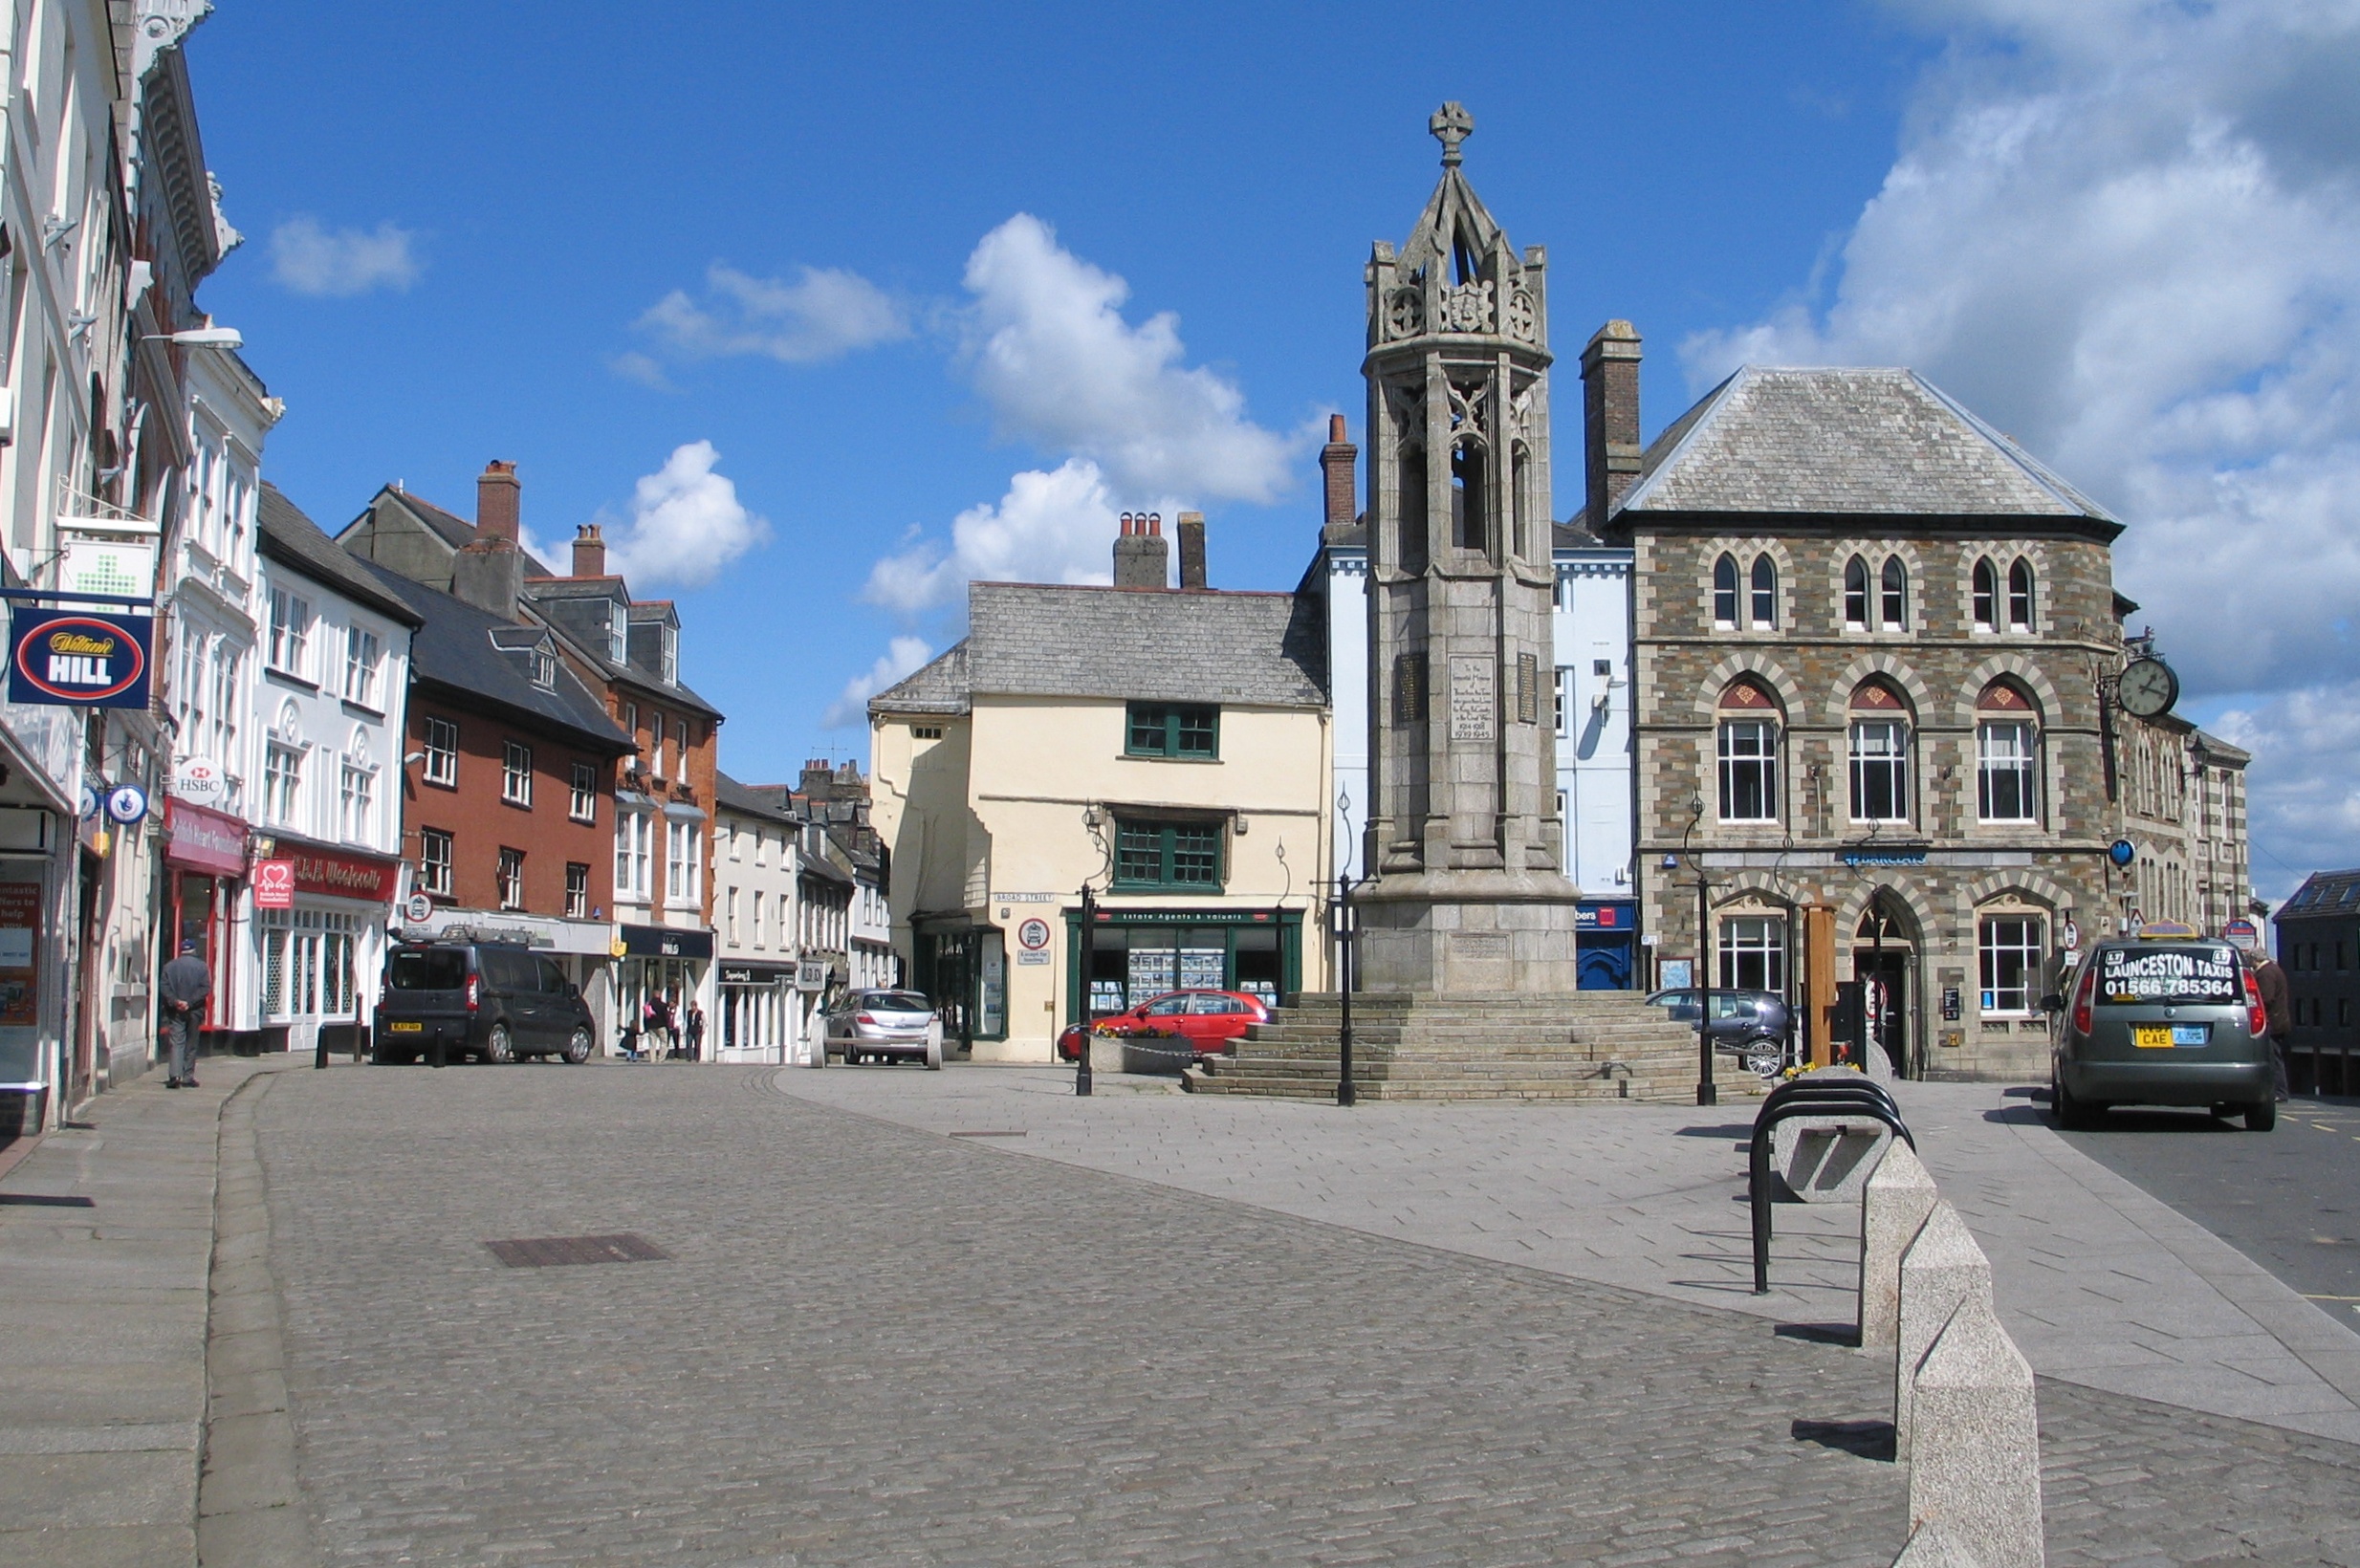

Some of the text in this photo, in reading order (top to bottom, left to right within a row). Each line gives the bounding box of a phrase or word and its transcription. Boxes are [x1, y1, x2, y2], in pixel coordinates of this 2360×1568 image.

[50, 632, 114, 654] William
[49, 655, 112, 685] HILL
[180, 779, 220, 793] HSBC
[1026, 893, 1054, 902] STREET
[2105, 954, 2234, 979] LAUNCESTON TAXIS
[2105, 980, 2234, 995] 01566 785364
[2143, 1034, 2167, 1045] CAE
